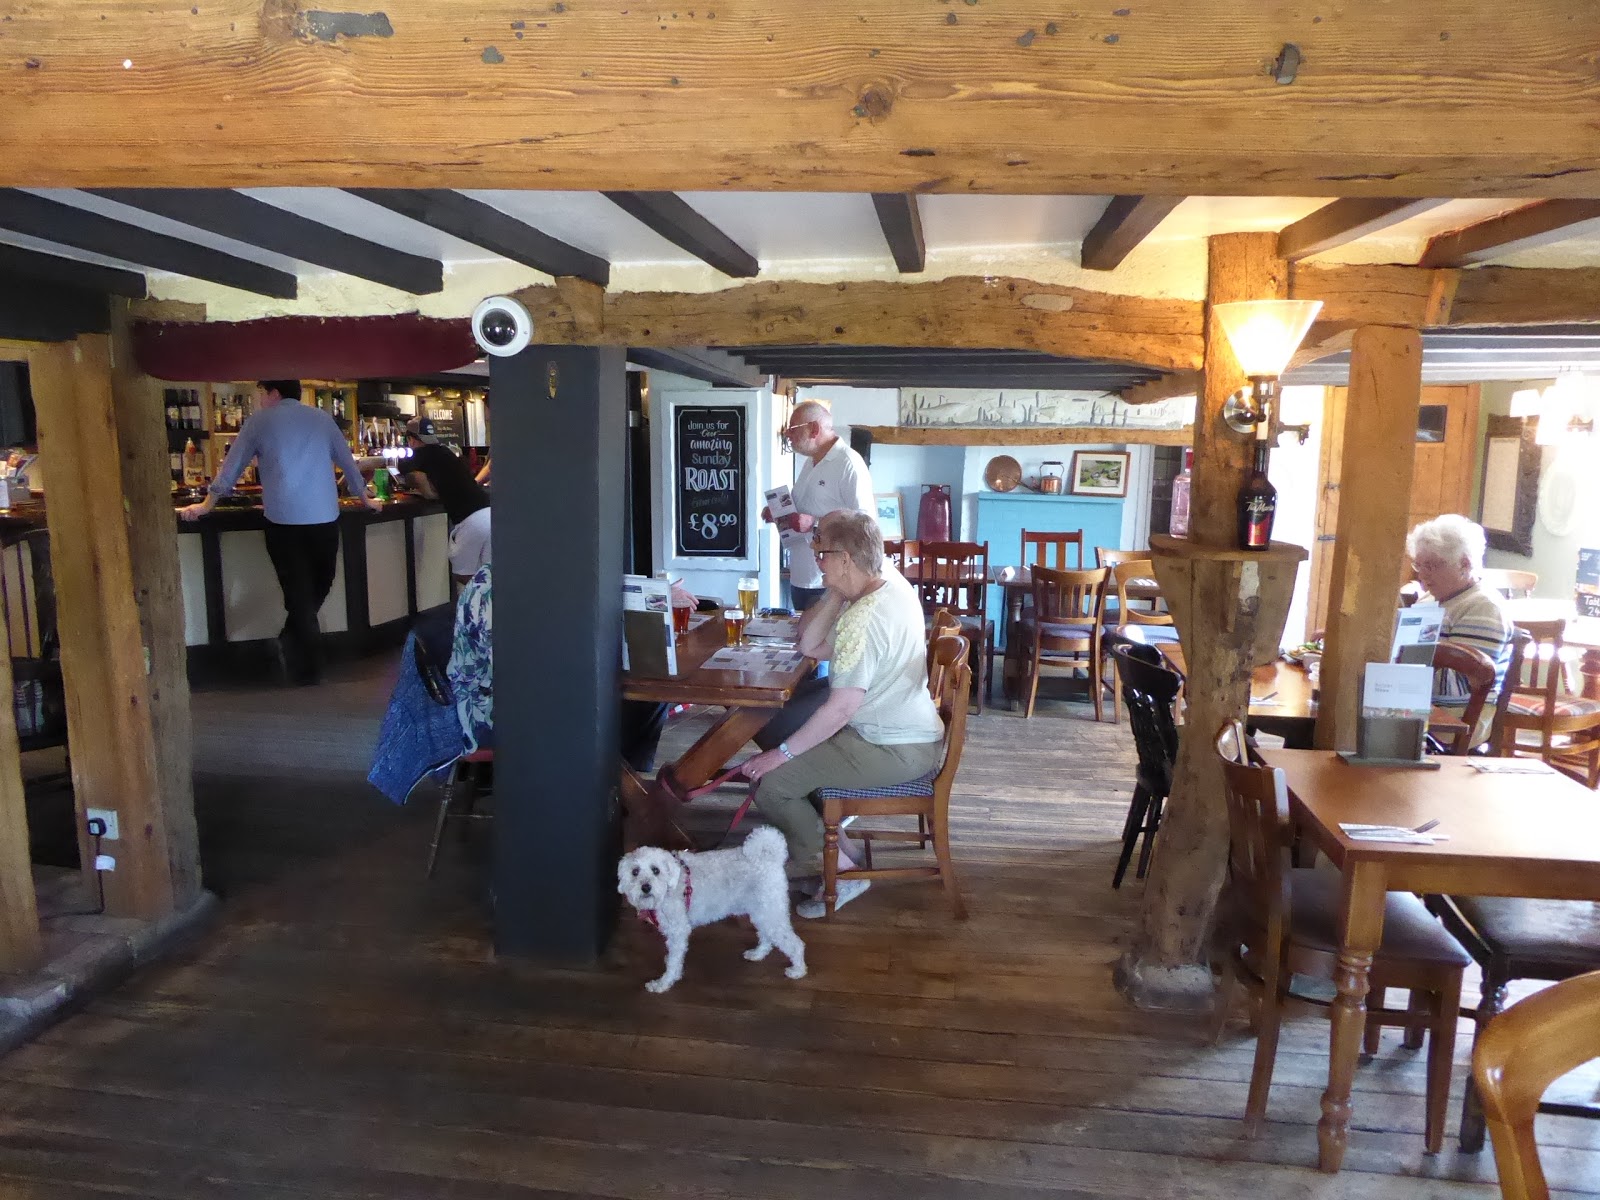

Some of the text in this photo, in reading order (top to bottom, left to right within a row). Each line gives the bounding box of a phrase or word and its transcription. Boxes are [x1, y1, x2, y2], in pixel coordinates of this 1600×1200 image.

[428, 409, 453, 420] WELCOME
[687, 420, 729, 430] Join us for
[690, 438, 733, 455] amazing
[691, 453, 732, 467] Sunday
[685, 467, 738, 491] ROAST
[688, 513, 737, 540] £8.99
